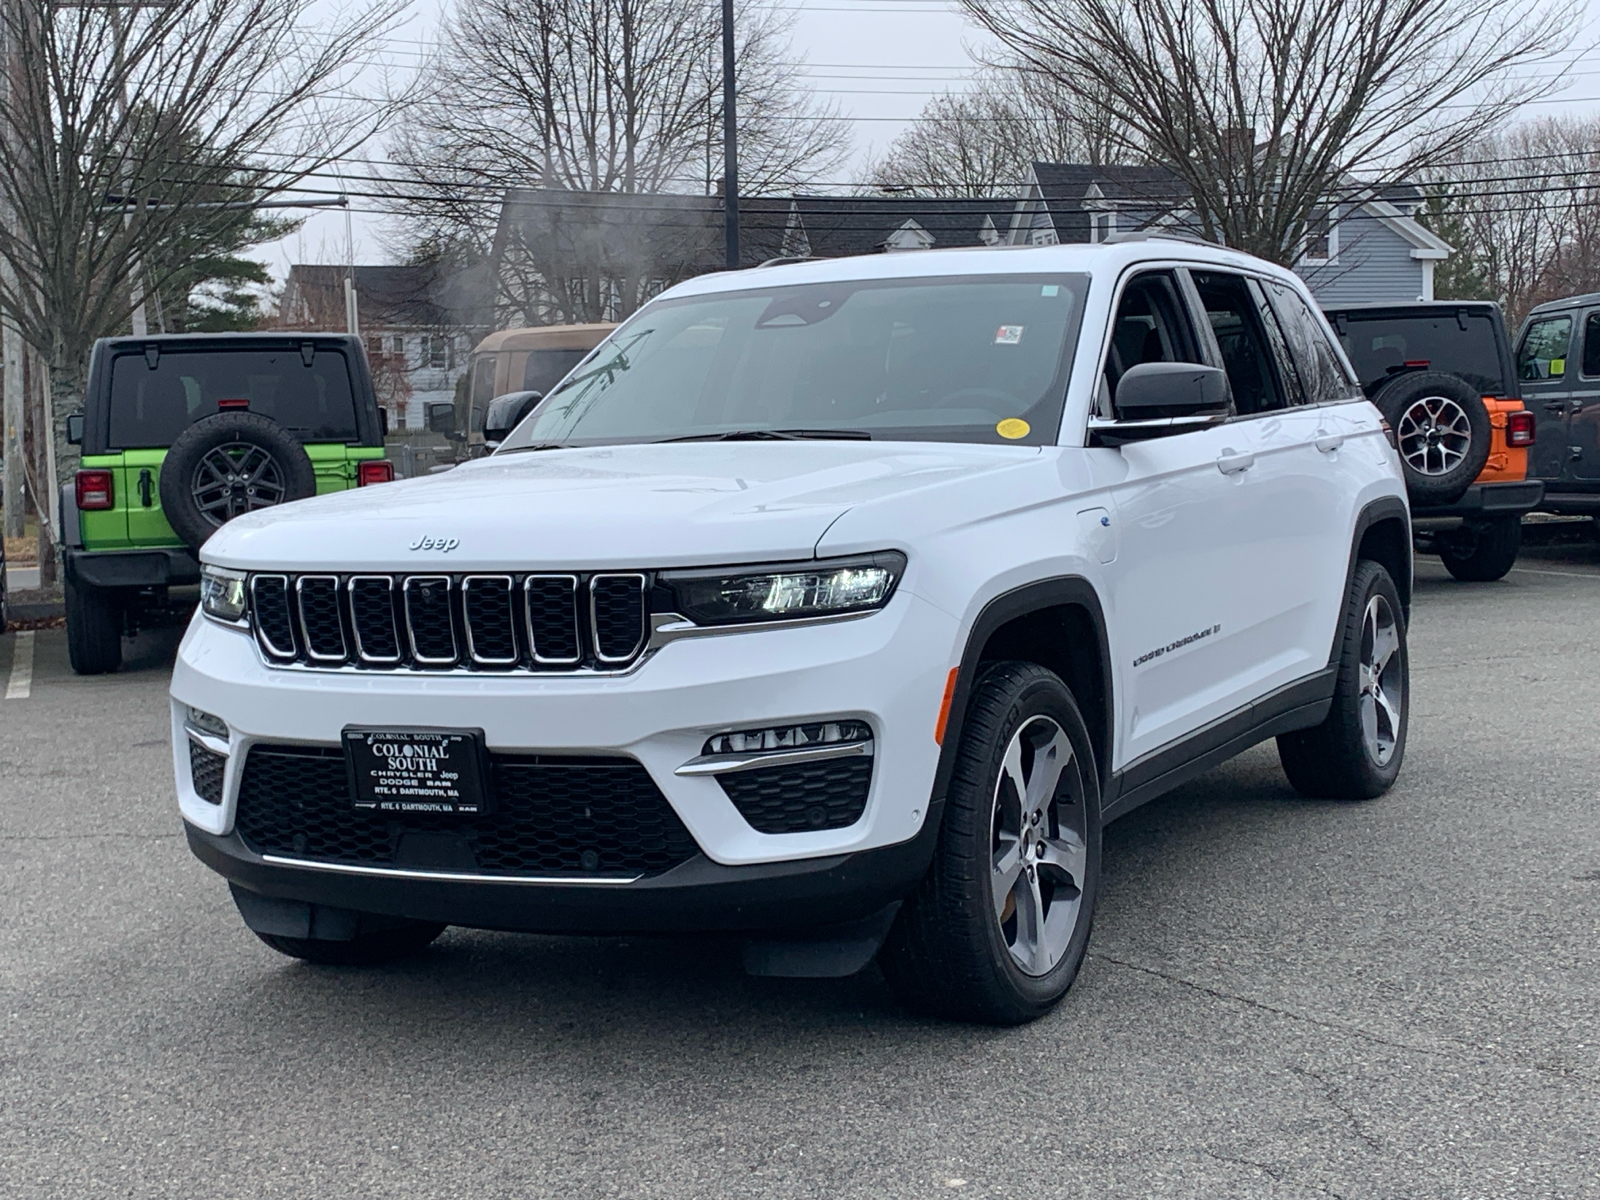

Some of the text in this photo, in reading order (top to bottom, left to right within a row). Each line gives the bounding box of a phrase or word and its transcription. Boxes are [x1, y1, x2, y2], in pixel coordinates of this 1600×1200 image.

[408, 534, 460, 553] Jeep
[371, 733, 410, 741] COLONIAL
[413, 734, 443, 742] SOUTH
[372, 743, 450, 759] COLONIAL
[388, 757, 438, 771] SOUTH
[370, 770, 459, 780] CHRYSLER Jeep
[379, 778, 419, 786] DODGE
[374, 787, 460, 797] RTE. 6 DARTMOUTH, MA
[380, 802, 395, 811] RTE.
[442, 804, 454, 812] MA
